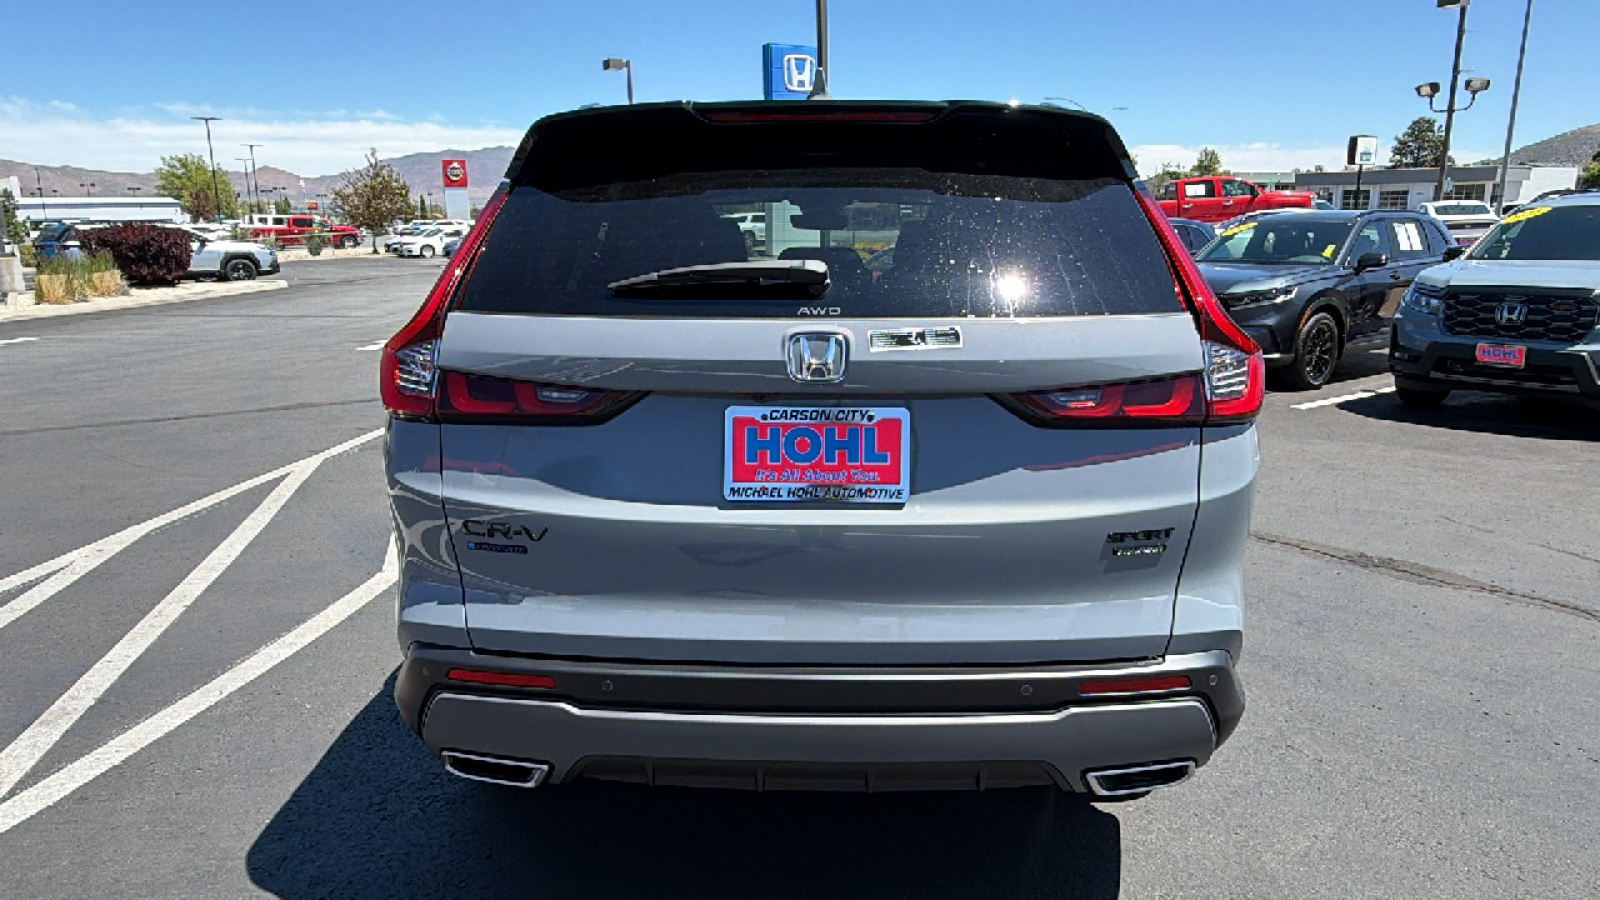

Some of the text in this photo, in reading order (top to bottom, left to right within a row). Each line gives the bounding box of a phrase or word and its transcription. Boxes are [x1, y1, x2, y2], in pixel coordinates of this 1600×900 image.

[797, 307, 841, 316] AWD
[1481, 349, 1520, 360] HOHL
[769, 409, 869, 422] CARSON CITY
[745, 426, 890, 465] HOHL
[755, 469, 880, 482] It's All About You.
[729, 487, 905, 500] MICHAEL HOHL AUTOMOTIVE
[462, 520, 550, 541] CR-V
[1106, 527, 1176, 543] SPORT
